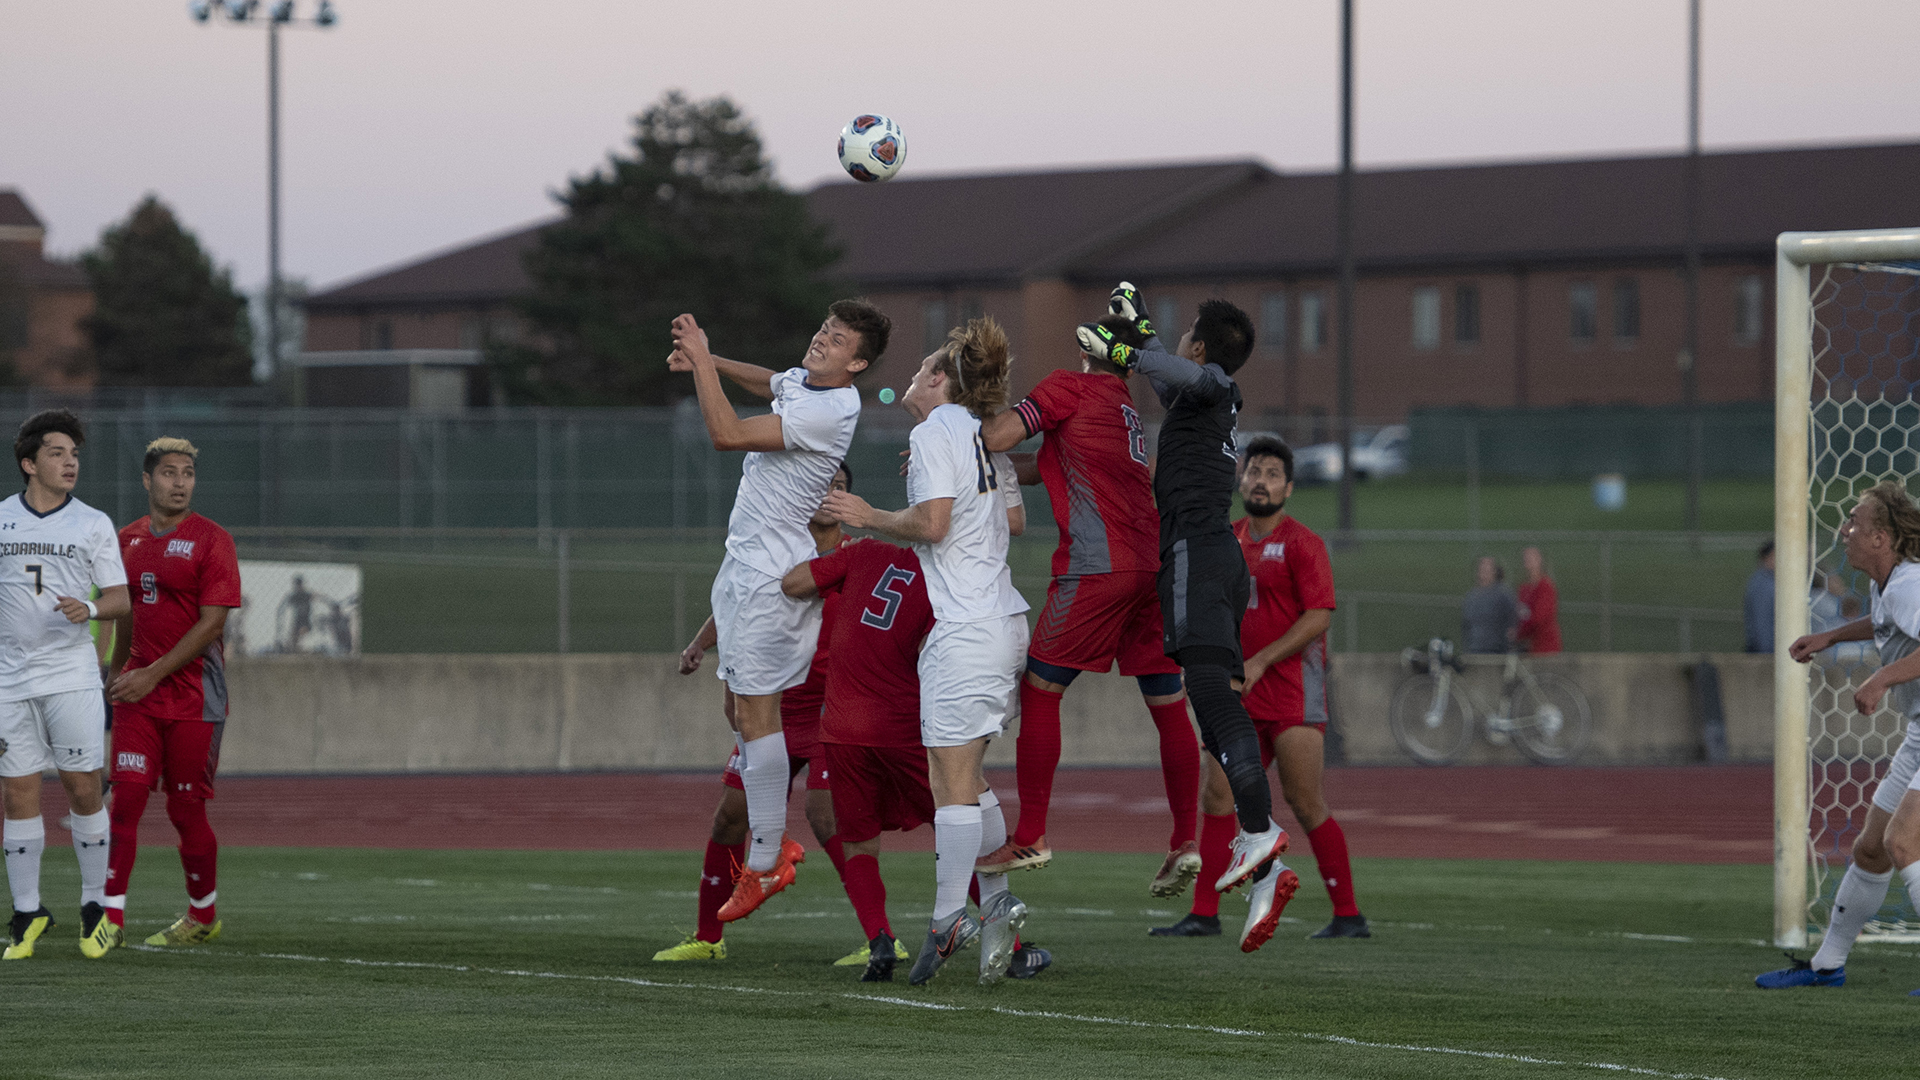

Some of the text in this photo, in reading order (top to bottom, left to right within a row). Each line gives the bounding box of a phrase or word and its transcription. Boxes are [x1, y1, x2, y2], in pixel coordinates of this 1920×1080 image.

[166, 539, 194, 554] OVU
[25, 565, 42, 596] 7
[141, 572, 157, 604] 9
[860, 563, 916, 630] 5
[118, 752, 146, 768] OVU
